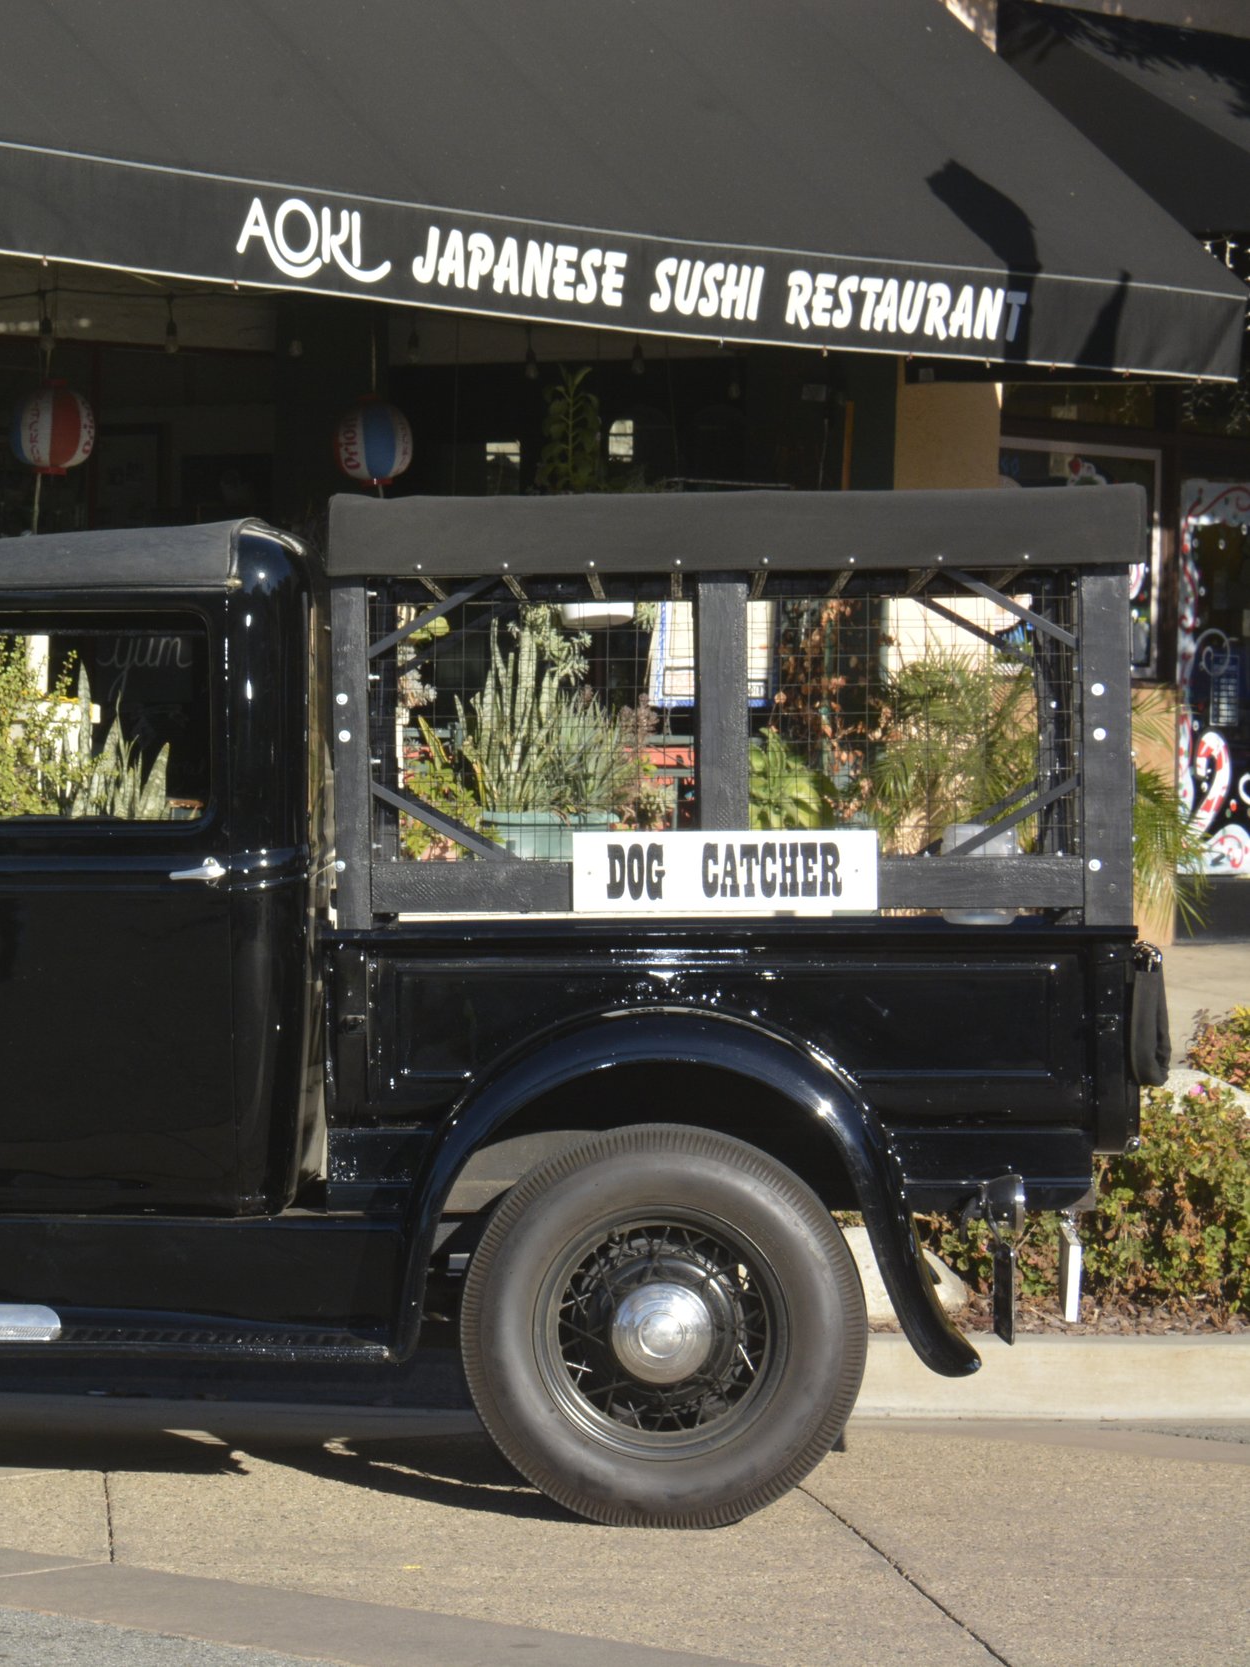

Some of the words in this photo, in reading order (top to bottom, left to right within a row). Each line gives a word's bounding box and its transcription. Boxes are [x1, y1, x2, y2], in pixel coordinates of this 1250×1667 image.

[235, 196, 392, 284] AOKI
[411, 225, 629, 308] JAPANESE
[648, 256, 766, 322] SUSHI
[784, 268, 1028, 344] RESTAURANT
[606, 842, 666, 900] DOG
[701, 841, 843, 898] CATCHER
